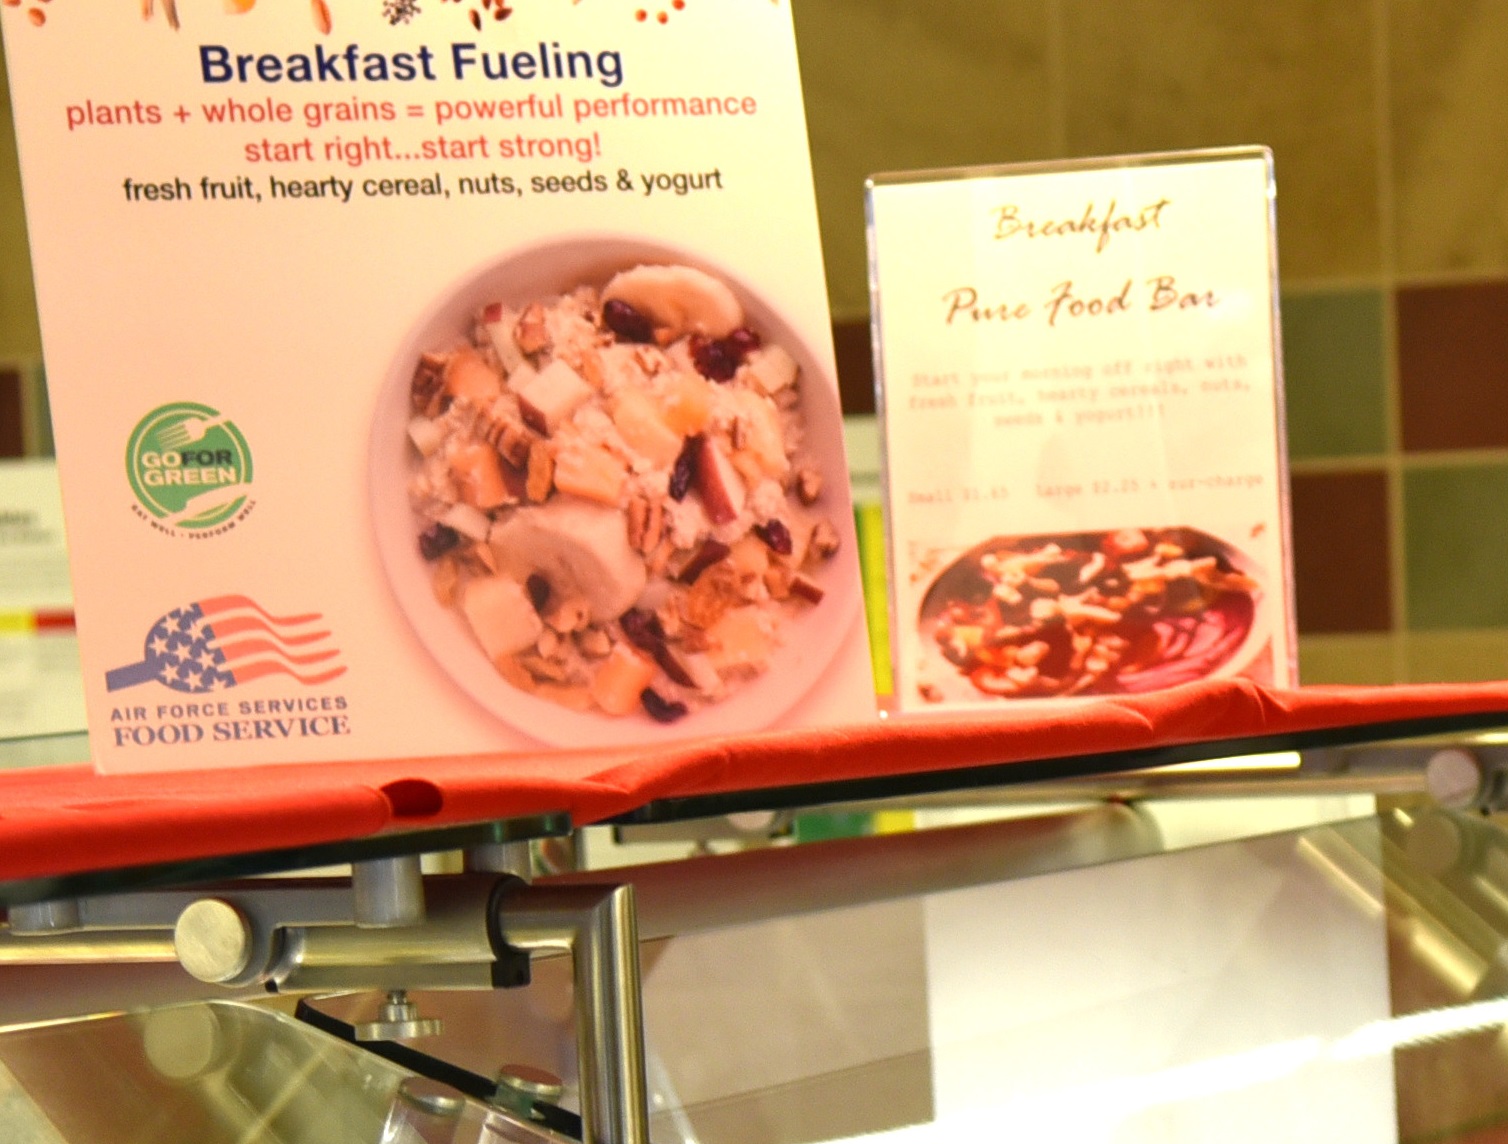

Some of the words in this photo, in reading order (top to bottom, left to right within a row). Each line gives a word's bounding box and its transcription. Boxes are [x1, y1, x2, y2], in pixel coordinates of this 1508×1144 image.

[199, 44, 437, 83] Breakfast
[452, 42, 624, 88] Fueling
[65, 99, 162, 131] plants
[173, 105, 191, 123] +
[202, 97, 293, 123] whole
[304, 96, 396, 128] grains
[435, 93, 563, 124] powerful
[573, 92, 757, 123] performance
[244, 137, 314, 163] start
[499, 132, 601, 163] strong!
[123, 177, 192, 201] fresh
[200, 175, 262, 203] fruit,
[269, 174, 353, 203] hearty
[362, 172, 451, 199] cereal,
[459, 172, 522, 198] nuts,
[531, 170, 608, 194] seeds
[616, 168, 634, 192] &
[641, 168, 723, 197] yogurt
[990, 198, 1170, 254] Breakfast
[941, 286, 1030, 326] Pure
[1044, 279, 1134, 327] Food
[1146, 275, 1221, 311] Bar
[911, 372, 959, 388] Start
[1102, 358, 1132, 376] off
[1204, 354, 1248, 370] with
[144, 466, 238, 487] GREEN
[110, 707, 147, 722] AIR
[157, 702, 229, 720] FORCE
[240, 696, 349, 715] SERVICES
[113, 723, 204, 748] FOOD
[213, 715, 351, 744] SERVICE
